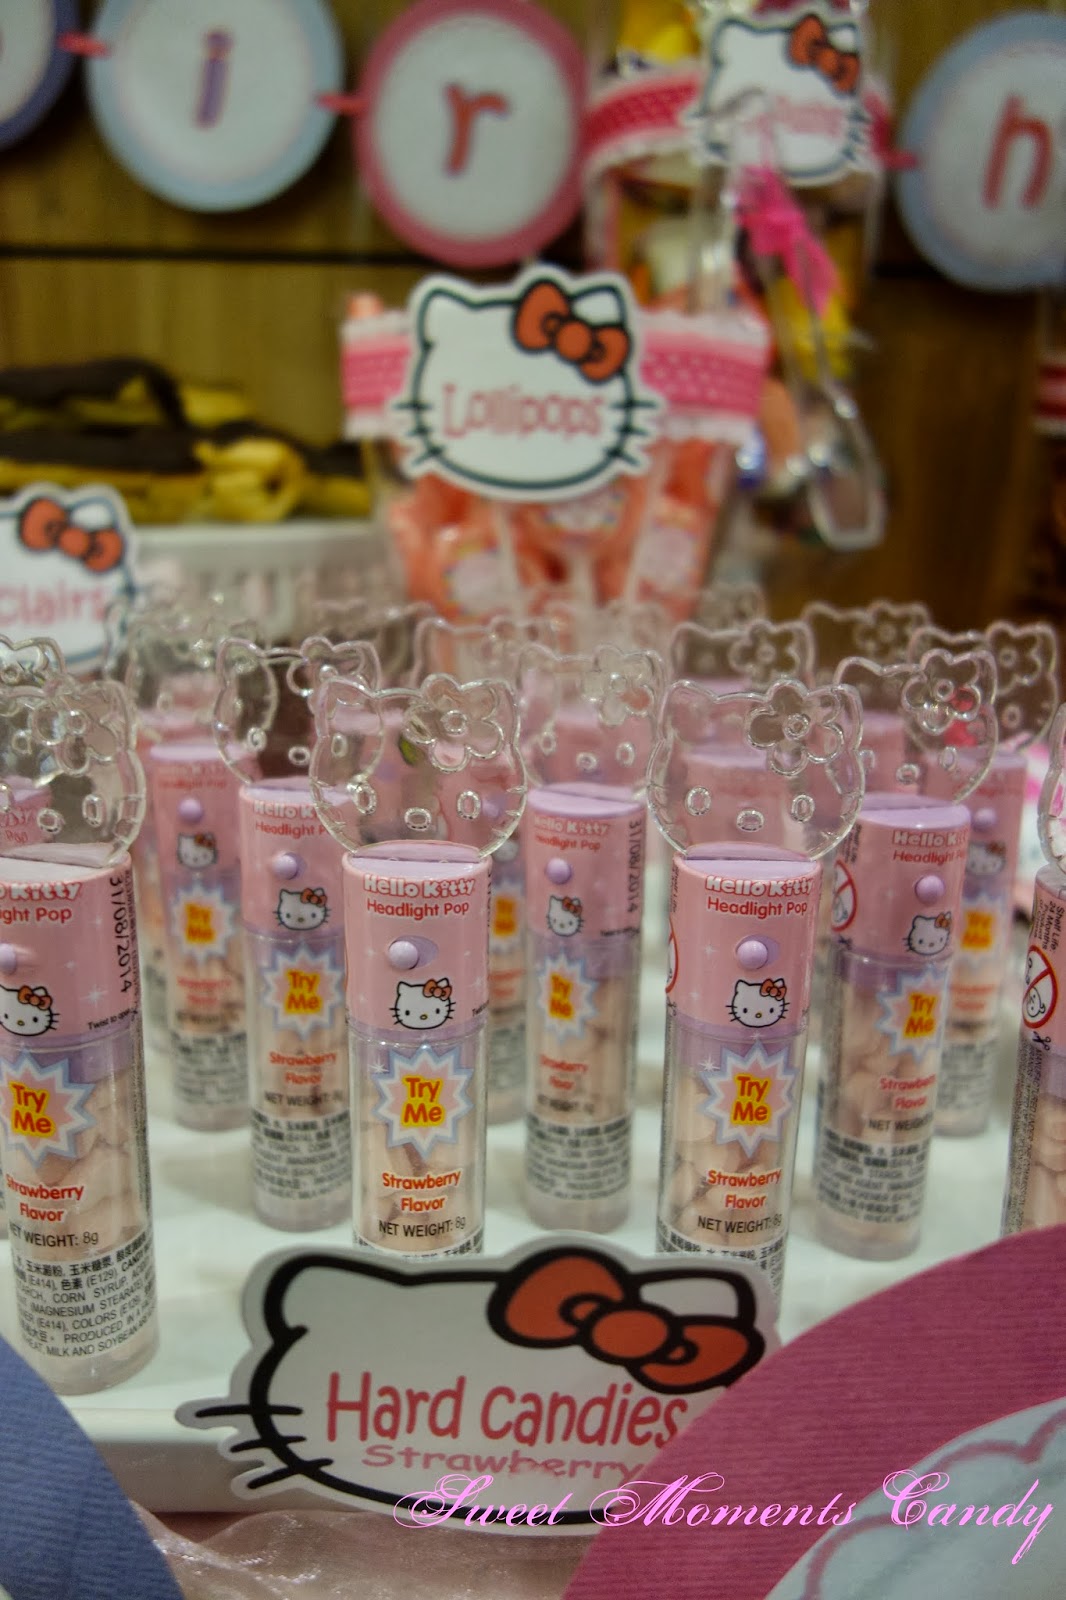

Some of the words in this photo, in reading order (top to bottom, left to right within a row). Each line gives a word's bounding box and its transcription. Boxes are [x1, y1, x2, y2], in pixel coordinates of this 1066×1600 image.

[196, 30, 232, 128] i
[444, 80, 510, 176] r
[981, 92, 1053, 209] n
[253, 800, 299, 819] Hello
[256, 821, 314, 839] Headlight
[892, 829, 945, 847] Hello
[363, 873, 419, 898] Hello
[422, 878, 476, 899] Kitty
[705, 875, 766, 897] Hello
[768, 877, 814, 897] Kitty
[36, 907, 73, 924] Pop
[367, 898, 439, 921] Headlight
[444, 902, 469, 916] Pop
[708, 896, 783, 919] Headlight
[787, 901, 807, 916] Pop
[1054, 906, 1065, 931] Shelf
[110, 876, 132, 993] 31/08/2014
[288, 971, 317, 993] Try
[287, 994, 320, 1010] Me
[911, 994, 935, 1014] Try
[905, 1017, 934, 1036] Me
[12, 1083, 46, 1113] Try
[405, 1077, 441, 1102] Try
[737, 1075, 768, 1102] Try
[14, 1110, 52, 1133] Me
[403, 1102, 442, 1124] Me
[733, 1101, 768, 1122] Me
[6, 1173, 84, 1200] Strawberry
[382, 1170, 462, 1190] Strawberry
[708, 1169, 782, 1187] Strawberry
[19, 1203, 64, 1222] Flavor
[401, 1197, 446, 1212] Flavor
[725, 1194, 766, 1209] Flavor
[379, 1219, 399, 1236] NET
[403, 1219, 454, 1238] WEIGHT:
[698, 1215, 721, 1232] NET
[725, 1217, 772, 1233] WEIGHT:
[24, 1230, 79, 1247] WEIGHT:
[83, 1231, 99, 1246] 8g
[52, 1292, 86, 1304] CORN
[72, 1309, 117, 1330] COLORS
[64, 1320, 123, 1344] PRODUCED
[327, 1371, 466, 1442] Hard
[361, 1444, 646, 1484] Strawberry
